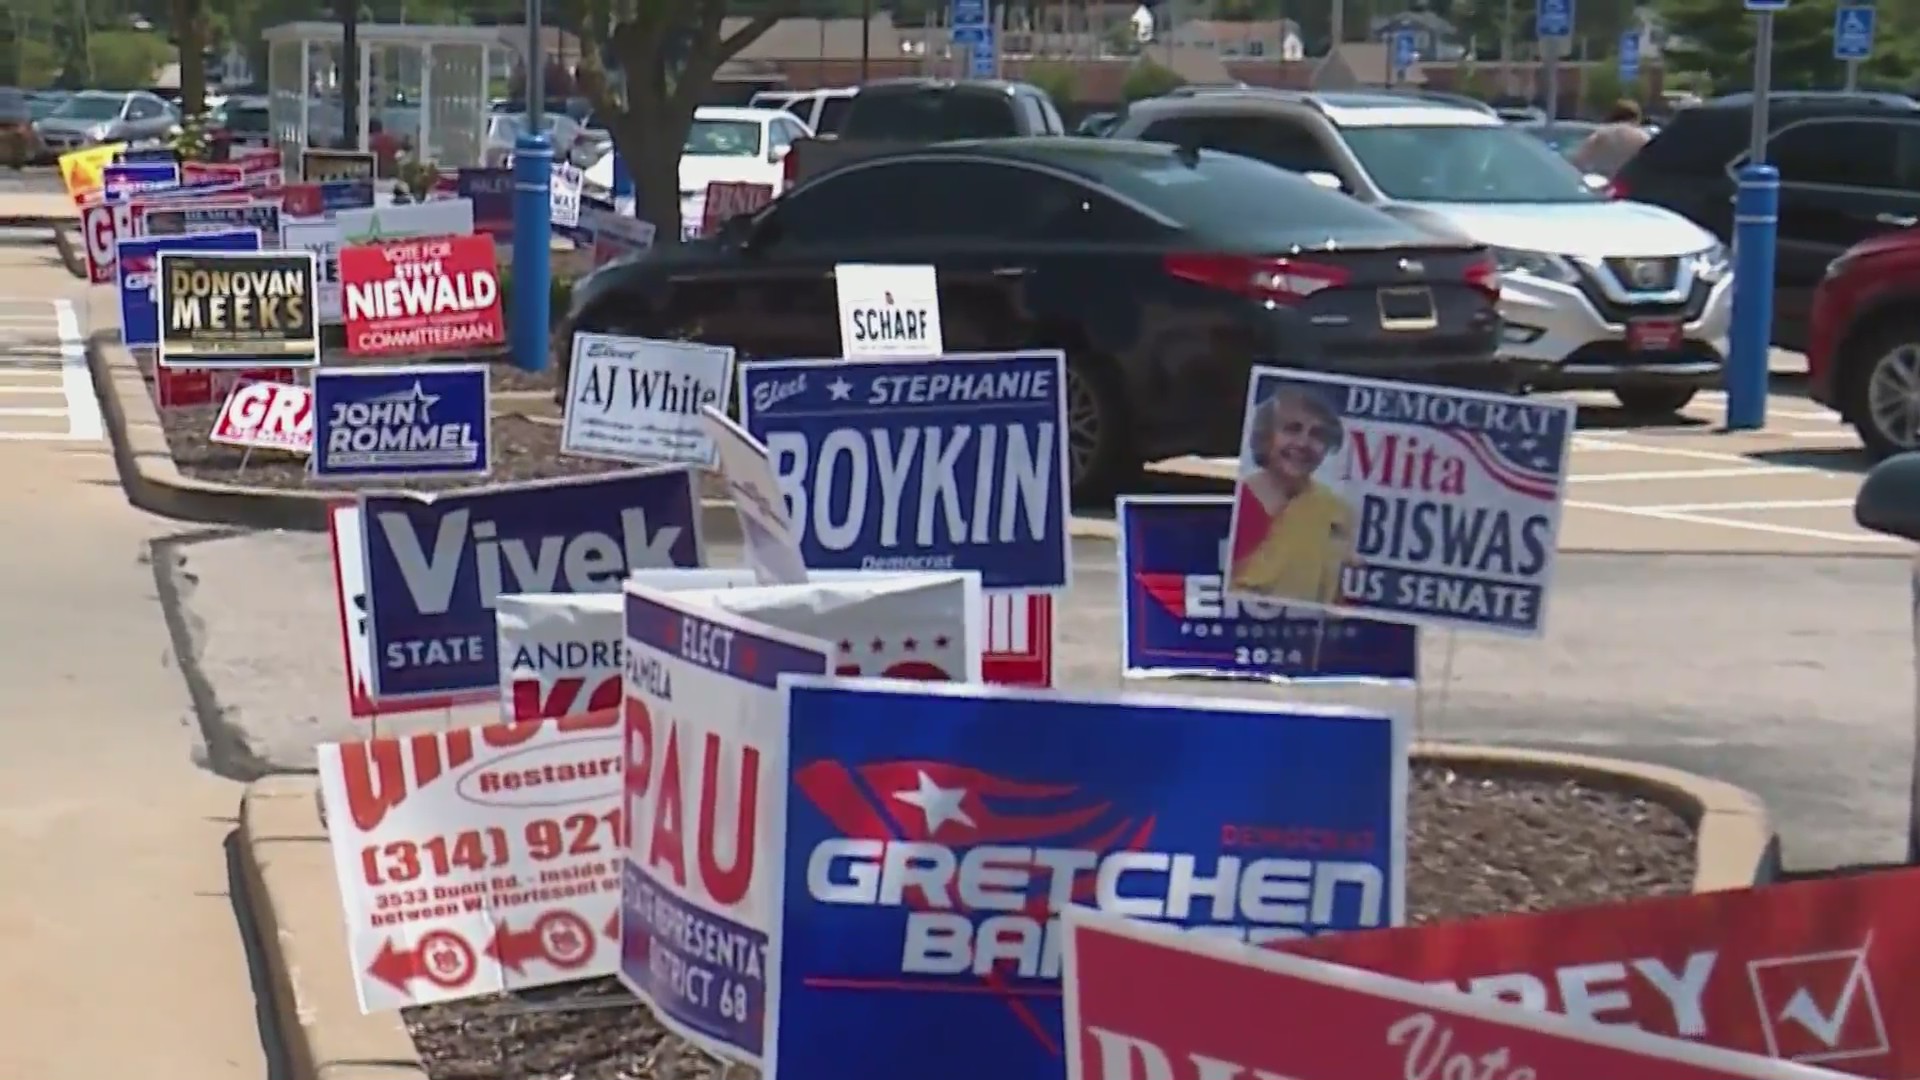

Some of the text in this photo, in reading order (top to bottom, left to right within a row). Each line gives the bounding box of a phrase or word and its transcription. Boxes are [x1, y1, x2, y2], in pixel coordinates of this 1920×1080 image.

[382, 242, 453, 262] VOTE FOR
[394, 260, 442, 278] STEVE
[171, 269, 303, 297] DONOVAN
[345, 269, 497, 320] NIEWALD
[172, 295, 303, 330] MEEKS
[853, 308, 927, 341] SCHARF
[358, 322, 495, 350] COMMITTEEMAN
[579, 363, 716, 415] AJ White
[752, 369, 1052, 412] Elect STEPHANIE
[329, 402, 416, 427] JOHN
[1346, 386, 1558, 436] DEMOCRAT
[329, 422, 479, 451] ROMMEL
[1342, 430, 1466, 495] Mita
[766, 421, 1054, 552] BOYKIN
[1356, 494, 1550, 576] BISWAS
[377, 505, 685, 615] Vivek
[1341, 567, 1385, 601] US
[1398, 575, 1533, 621] SENATE
[681, 615, 735, 670] ELECT
[1180, 622, 1224, 637] FOR
[386, 635, 484, 669] STATE
[1234, 646, 1303, 665] 2024
[623, 696, 760, 906] PAU
[360, 827, 510, 887] (314)
[1220, 824, 1376, 849] DEMOCRAT
[374, 887, 428, 910] 3533
[433, 880, 487, 901] Dunn
[540, 863, 606, 884] Inside
[806, 837, 1384, 926] GRETCHEN
[370, 905, 459, 928] between
[719, 979, 748, 1023] 68
